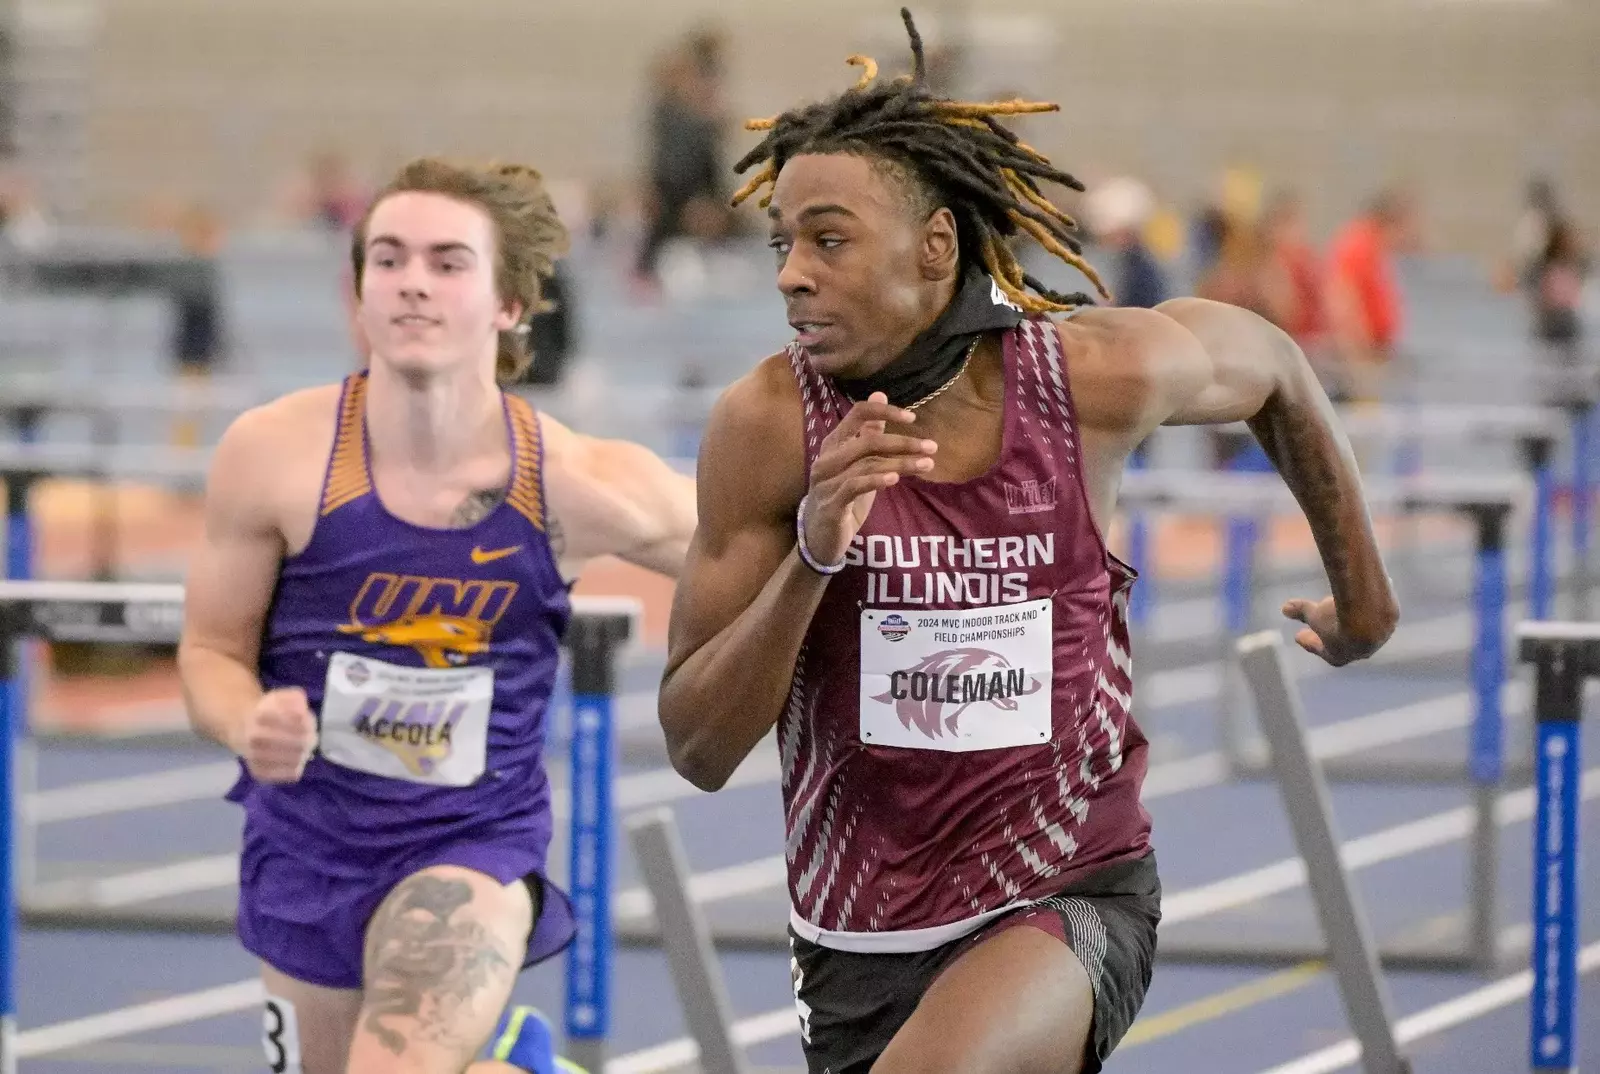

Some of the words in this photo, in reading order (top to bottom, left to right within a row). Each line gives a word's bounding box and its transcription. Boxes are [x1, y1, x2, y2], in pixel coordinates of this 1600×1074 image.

[845, 533, 1055, 569] SOUTHERN
[350, 572, 520, 627] UNI
[867, 572, 1029, 604] ILLINOIS
[917, 618, 939, 628] 2024
[941, 619, 960, 629] MVC
[962, 616, 993, 629] INDOOR
[994, 612, 1020, 625] TRACK
[1021, 609, 1038, 621] AND
[934, 632, 958, 643] FIELD
[959, 626, 1026, 643] CHAMPIONSHIPS
[890, 668, 1026, 704] COLEMAN
[355, 714, 452, 746] ACCOLA
